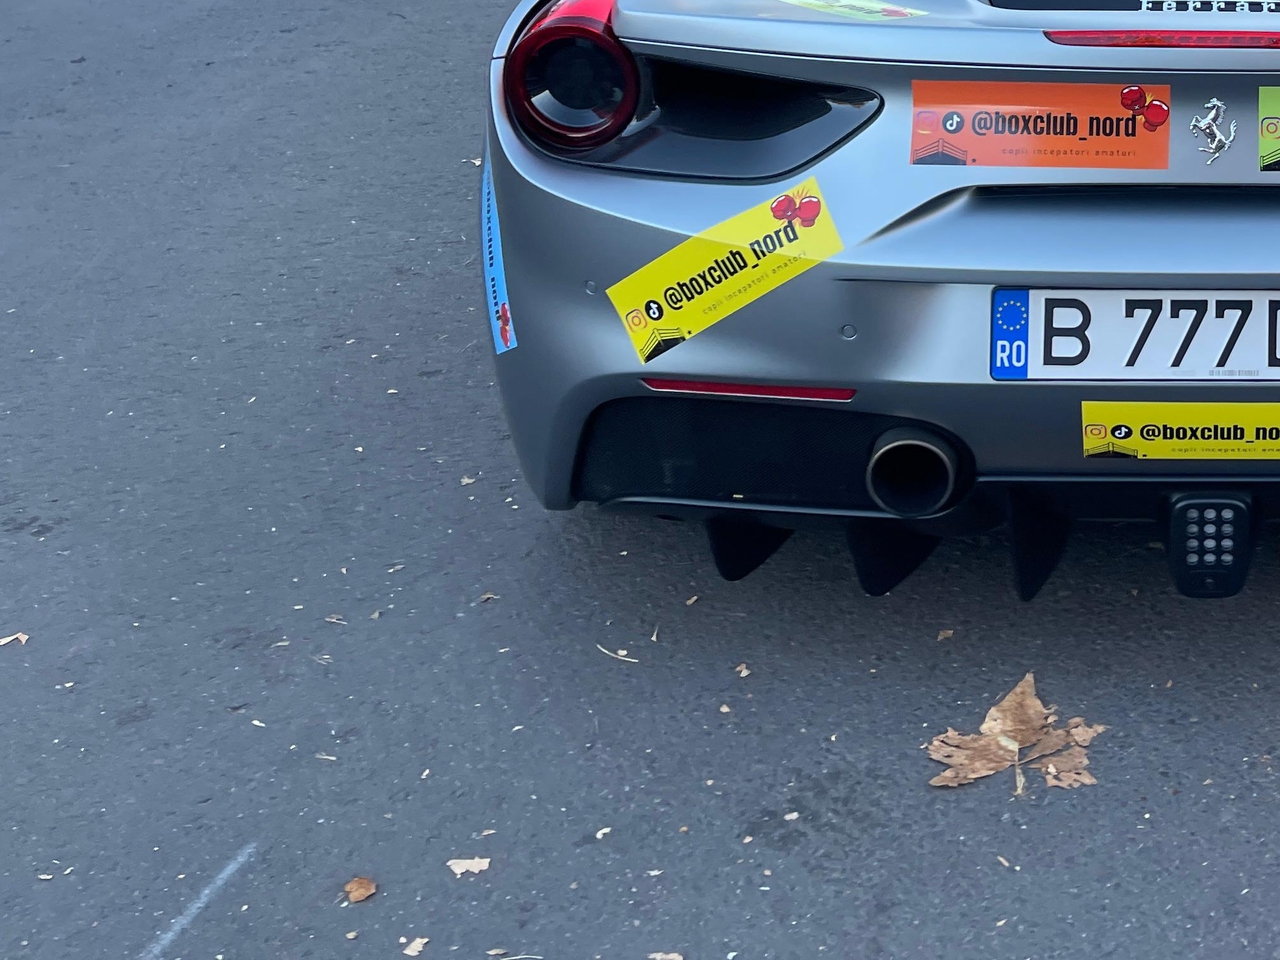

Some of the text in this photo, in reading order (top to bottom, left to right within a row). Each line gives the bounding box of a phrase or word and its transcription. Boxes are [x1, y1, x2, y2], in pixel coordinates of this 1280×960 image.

[971, 110, 1137, 141] @boxclub_nord
[1002, 147, 1137, 157] copii incepatori amatori
[664, 219, 799, 311] @boxclub_nord
[772, 250, 807, 275] amatori
[1043, 297, 1092, 366] B
[1122, 298, 1254, 368] 777
[996, 340, 1026, 368] RO
